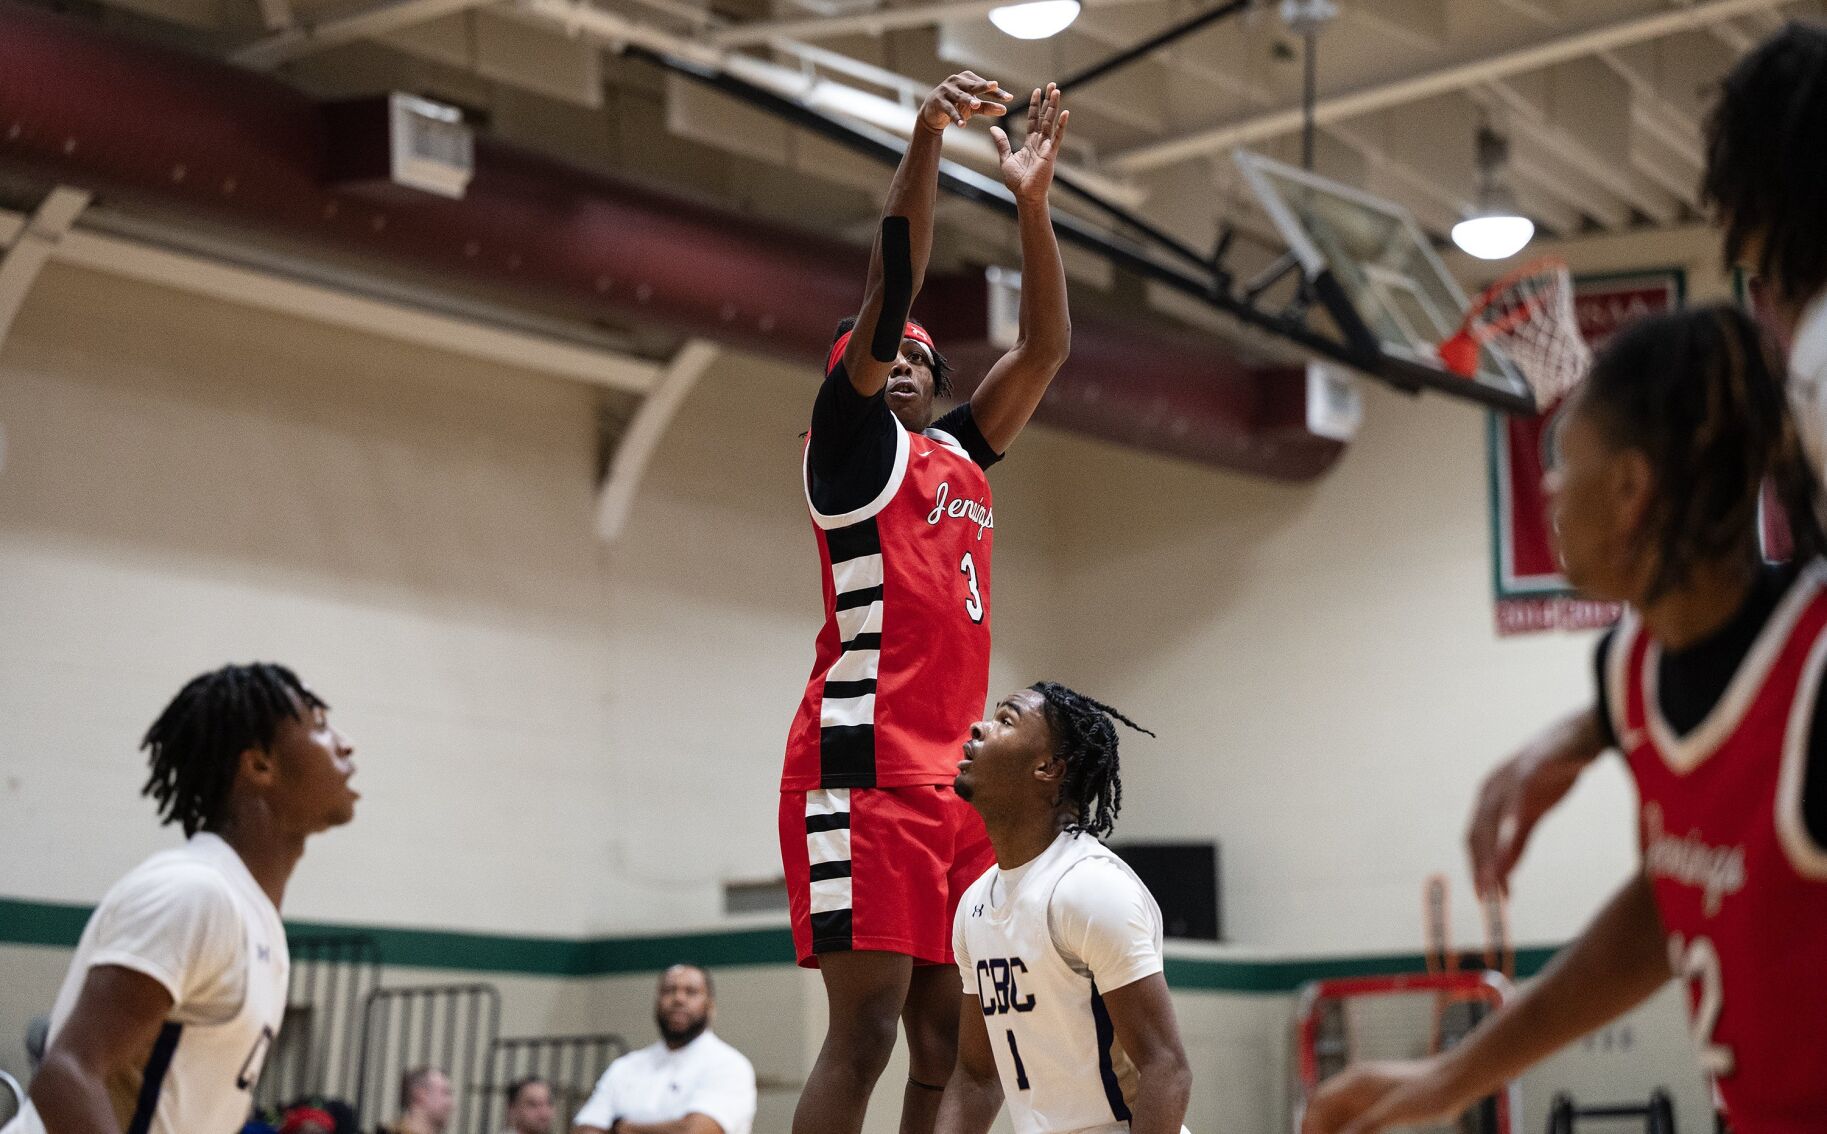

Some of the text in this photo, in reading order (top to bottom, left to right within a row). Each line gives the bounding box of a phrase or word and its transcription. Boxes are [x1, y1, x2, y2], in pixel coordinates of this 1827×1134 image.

[960, 551, 984, 625] 3
[976, 957, 1036, 1016] CBC
[1006, 1029, 1031, 1091] 1
